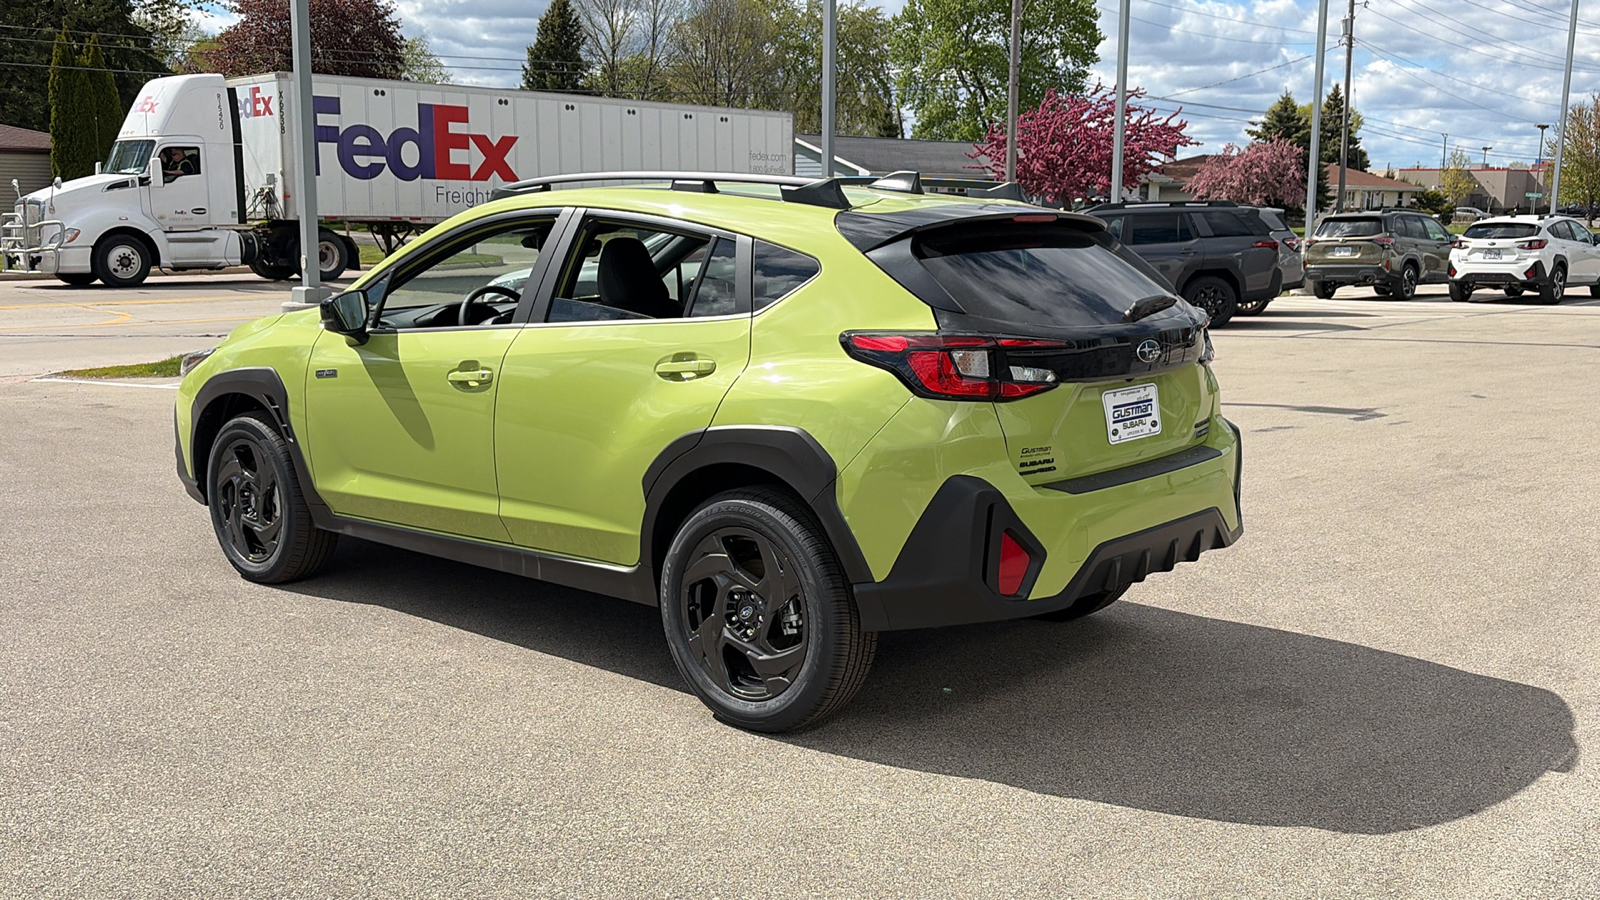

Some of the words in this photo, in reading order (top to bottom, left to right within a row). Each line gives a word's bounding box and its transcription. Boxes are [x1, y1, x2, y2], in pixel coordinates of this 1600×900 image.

[238, 87, 273, 118] edEx
[312, 95, 520, 182] FedEx
[749, 150, 787, 161] fedex.com
[436, 186, 491, 208] Freight
[1122, 418, 1147, 430] SUBARU
[1019, 457, 1054, 467] SUBARU
